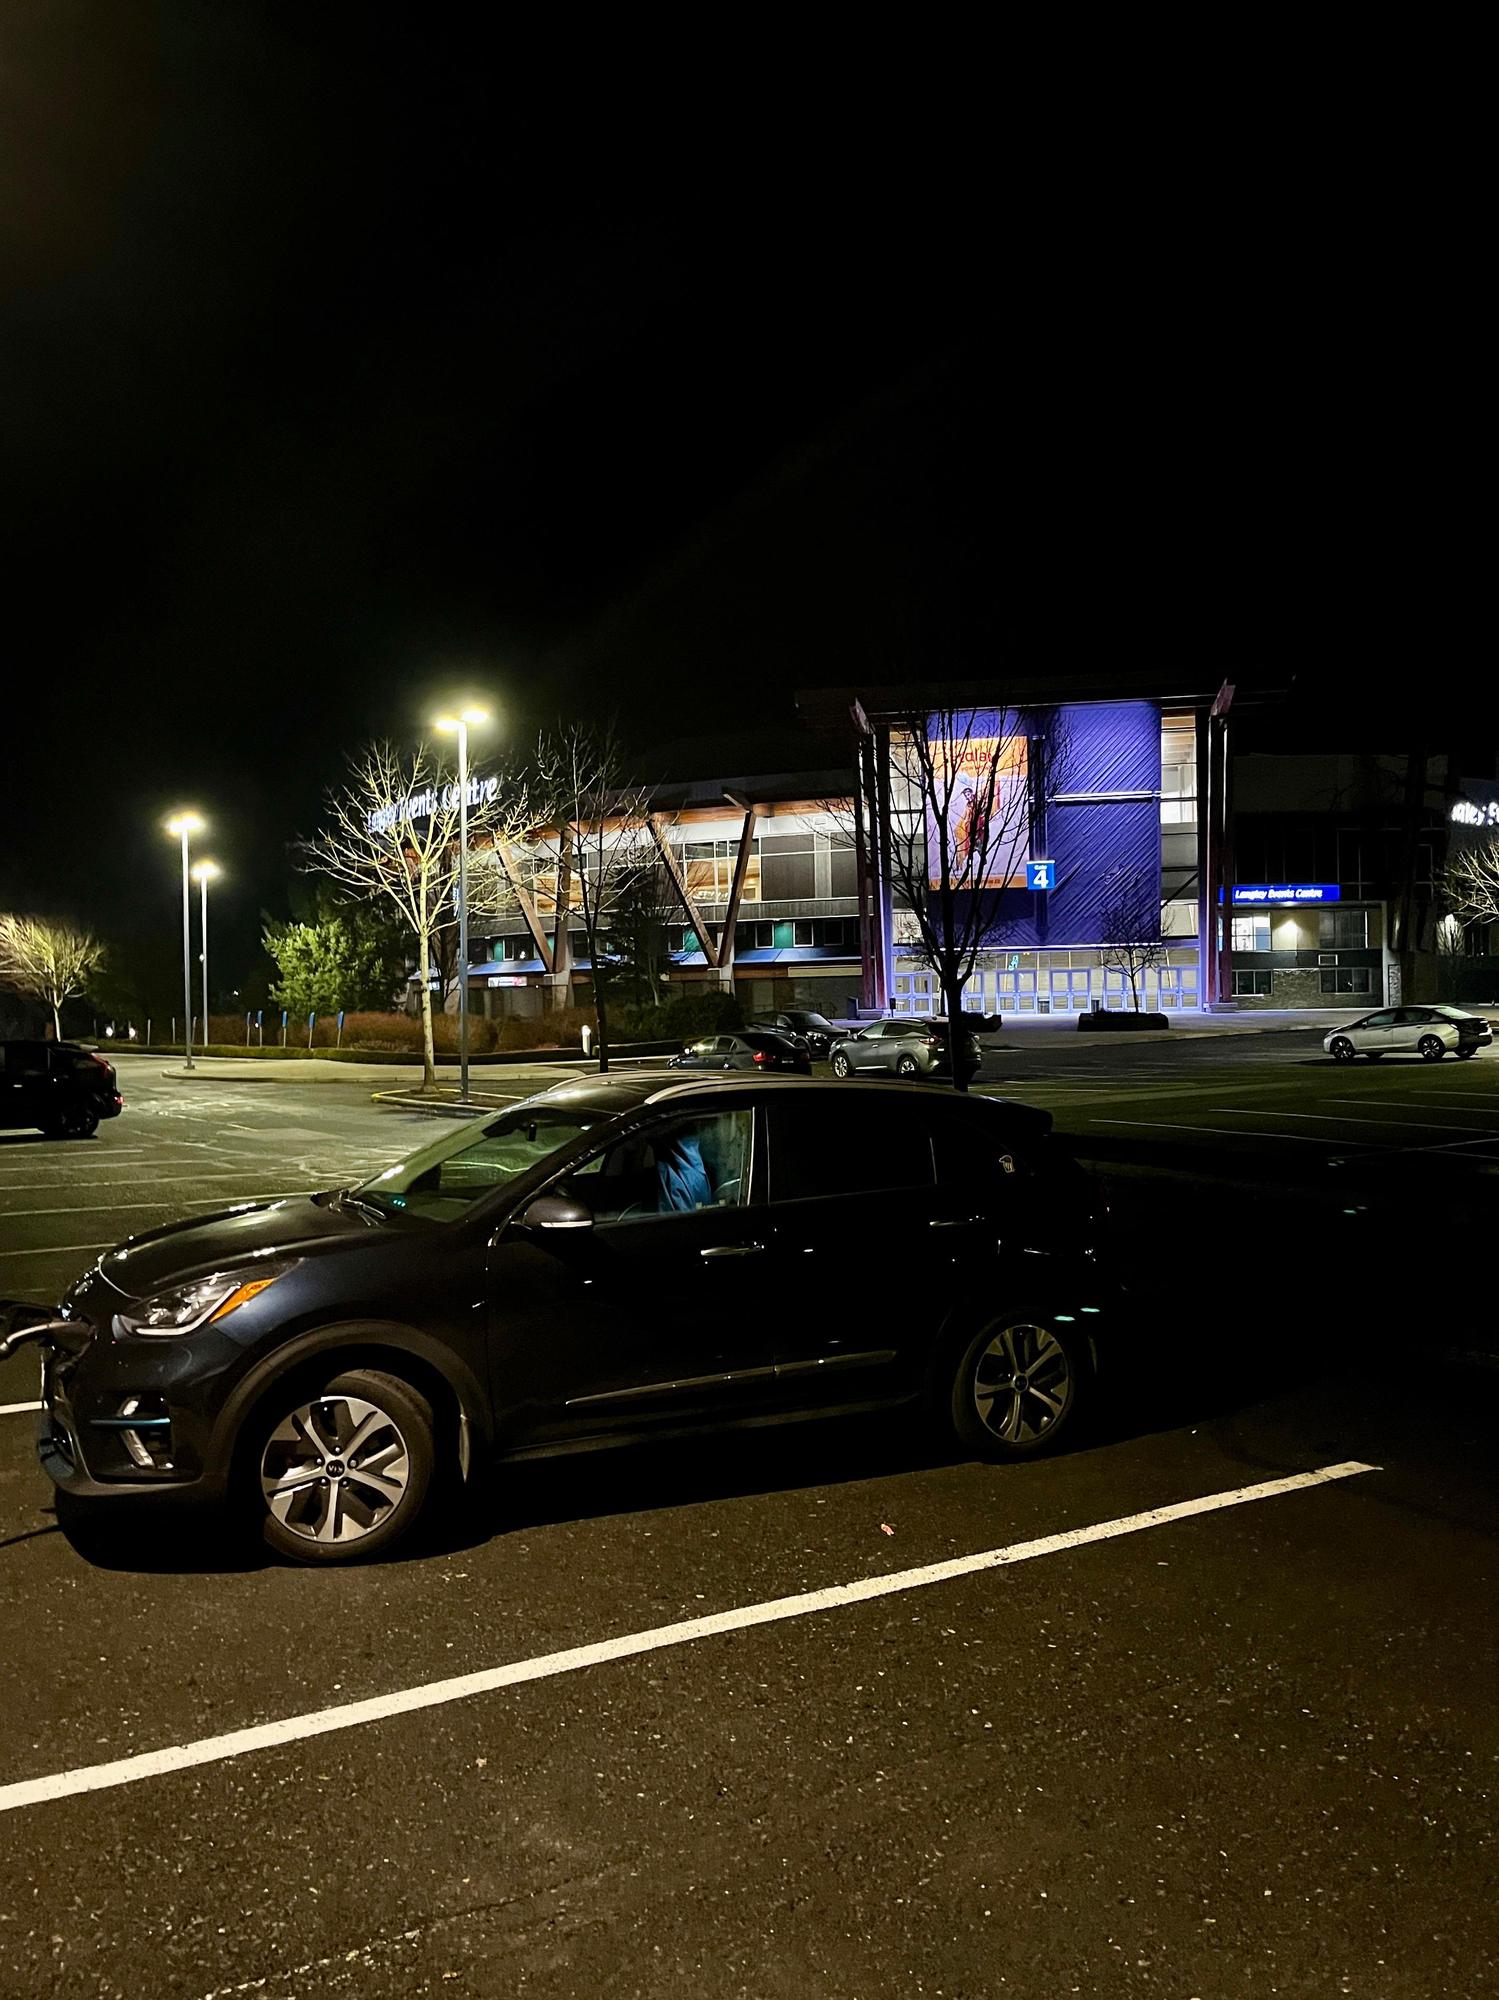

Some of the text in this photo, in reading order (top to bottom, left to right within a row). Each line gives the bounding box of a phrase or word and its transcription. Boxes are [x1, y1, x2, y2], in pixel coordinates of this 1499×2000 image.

[1033, 870, 1049, 889] 4
[1235, 889, 1322, 900] Langley Events Centre
